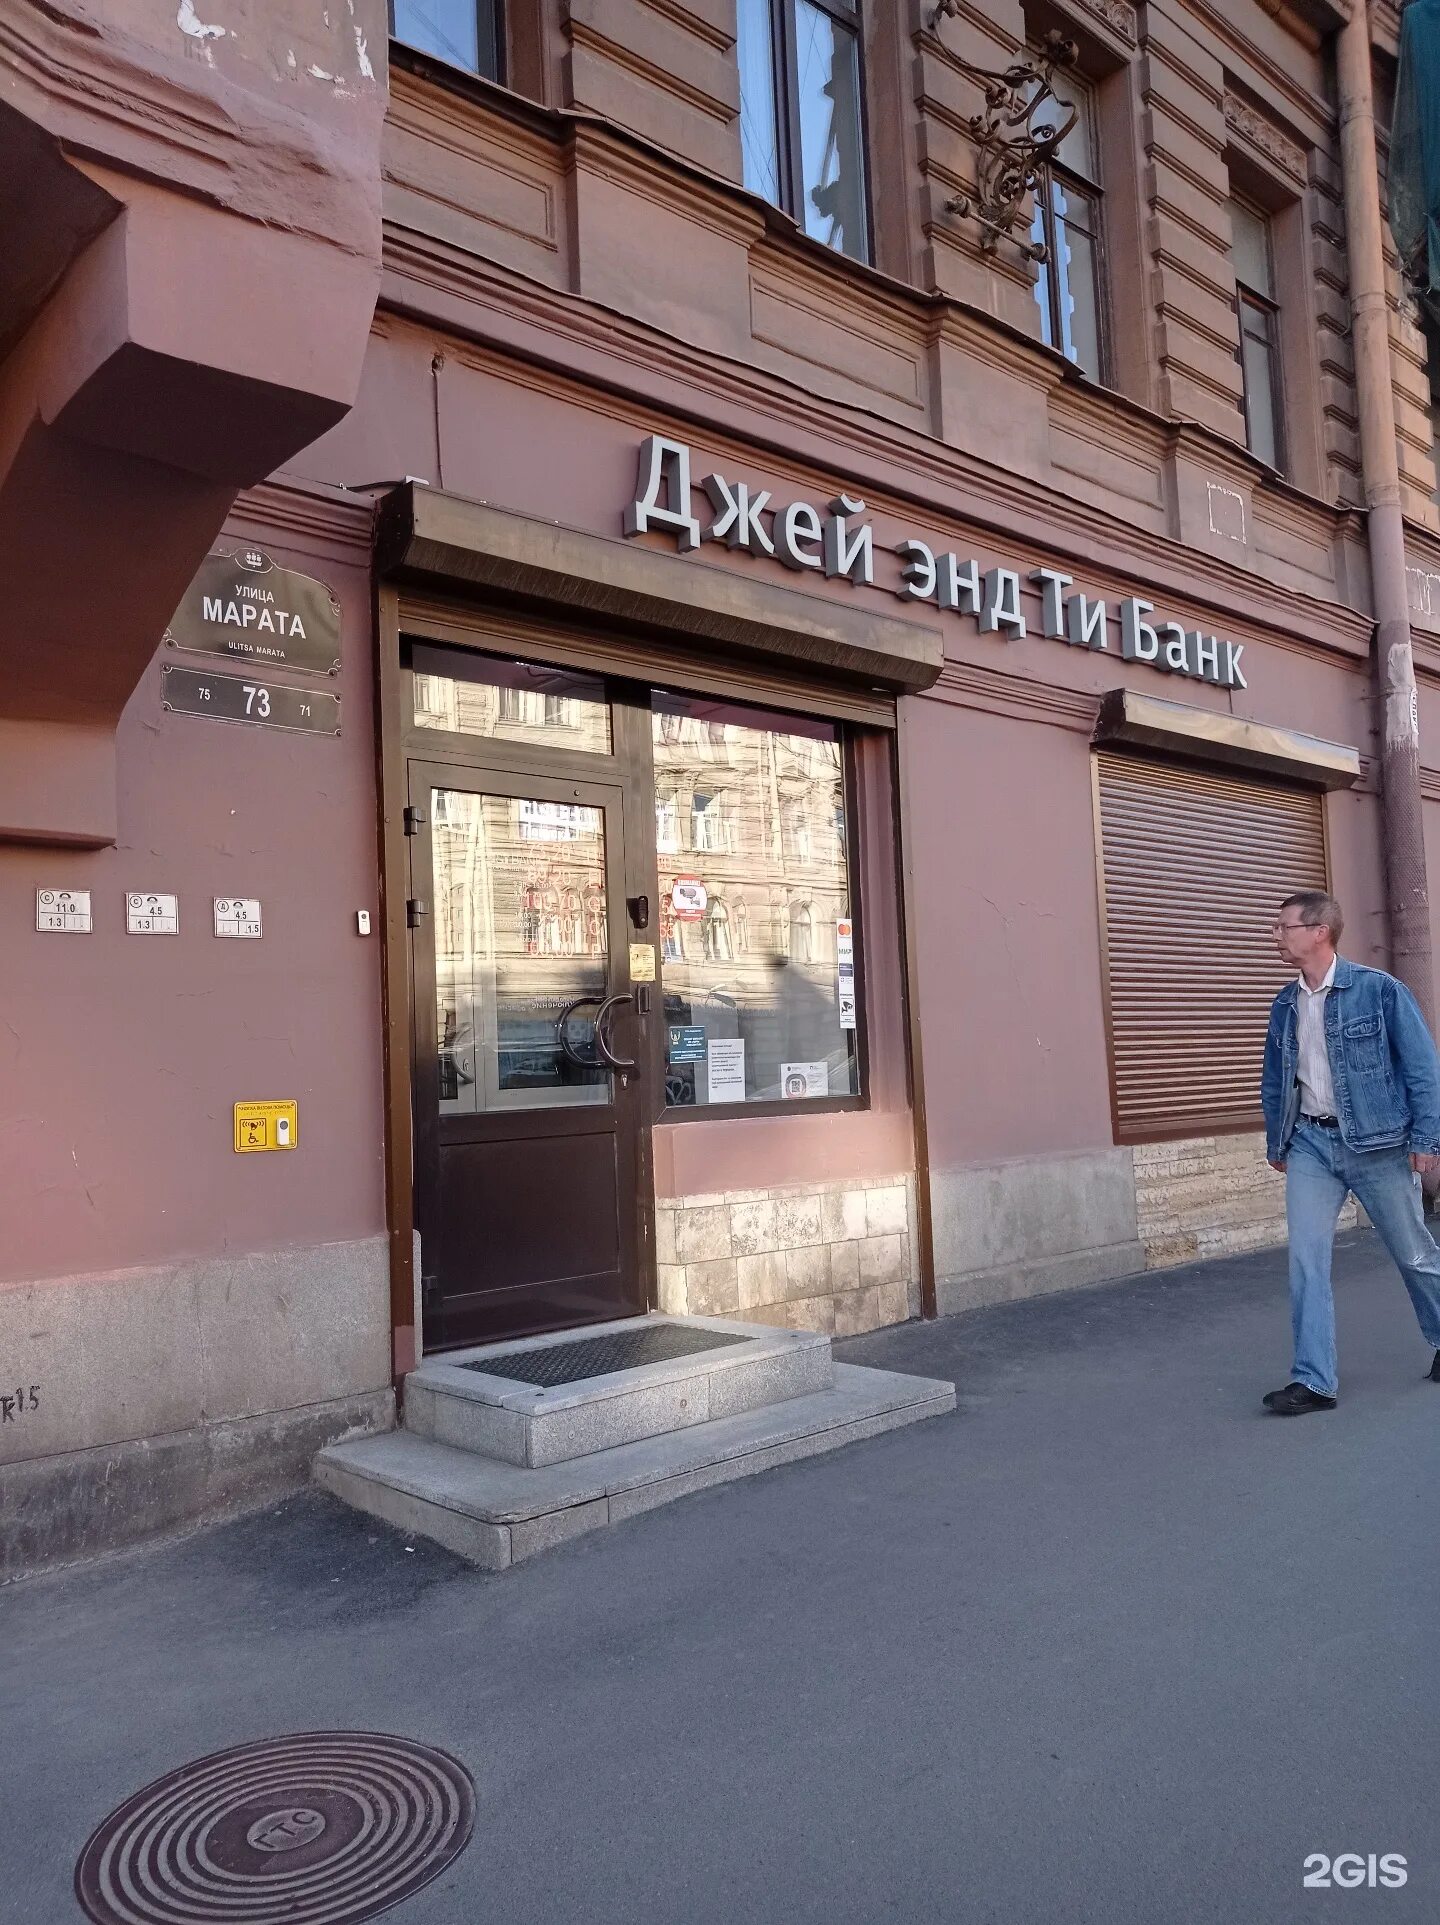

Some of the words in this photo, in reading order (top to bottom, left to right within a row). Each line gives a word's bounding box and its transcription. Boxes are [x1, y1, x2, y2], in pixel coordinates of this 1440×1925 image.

[626, 435, 874, 585] Джей
[901, 540, 1027, 641] энд
[1030, 568, 1108, 651] Ти
[1122, 596, 1248, 691] Банк
[235, 584, 274, 603] УЛИЦА
[203, 596, 307, 640] МАРАТА
[228, 641, 254, 653] ULITSA
[256, 644, 286, 659] MARATA
[198, 687, 211, 700] 75
[242, 685, 271, 717] 73
[300, 704, 311, 717] 71
[56, 903, 75, 913] 11.0
[149, 906, 162, 915] 4.5
[49, 917, 61, 927] 1.3
[235, 911, 247, 920] 4.5
[138, 920, 150, 929] 1.3
[247, 924, 259, 933] 1.5
